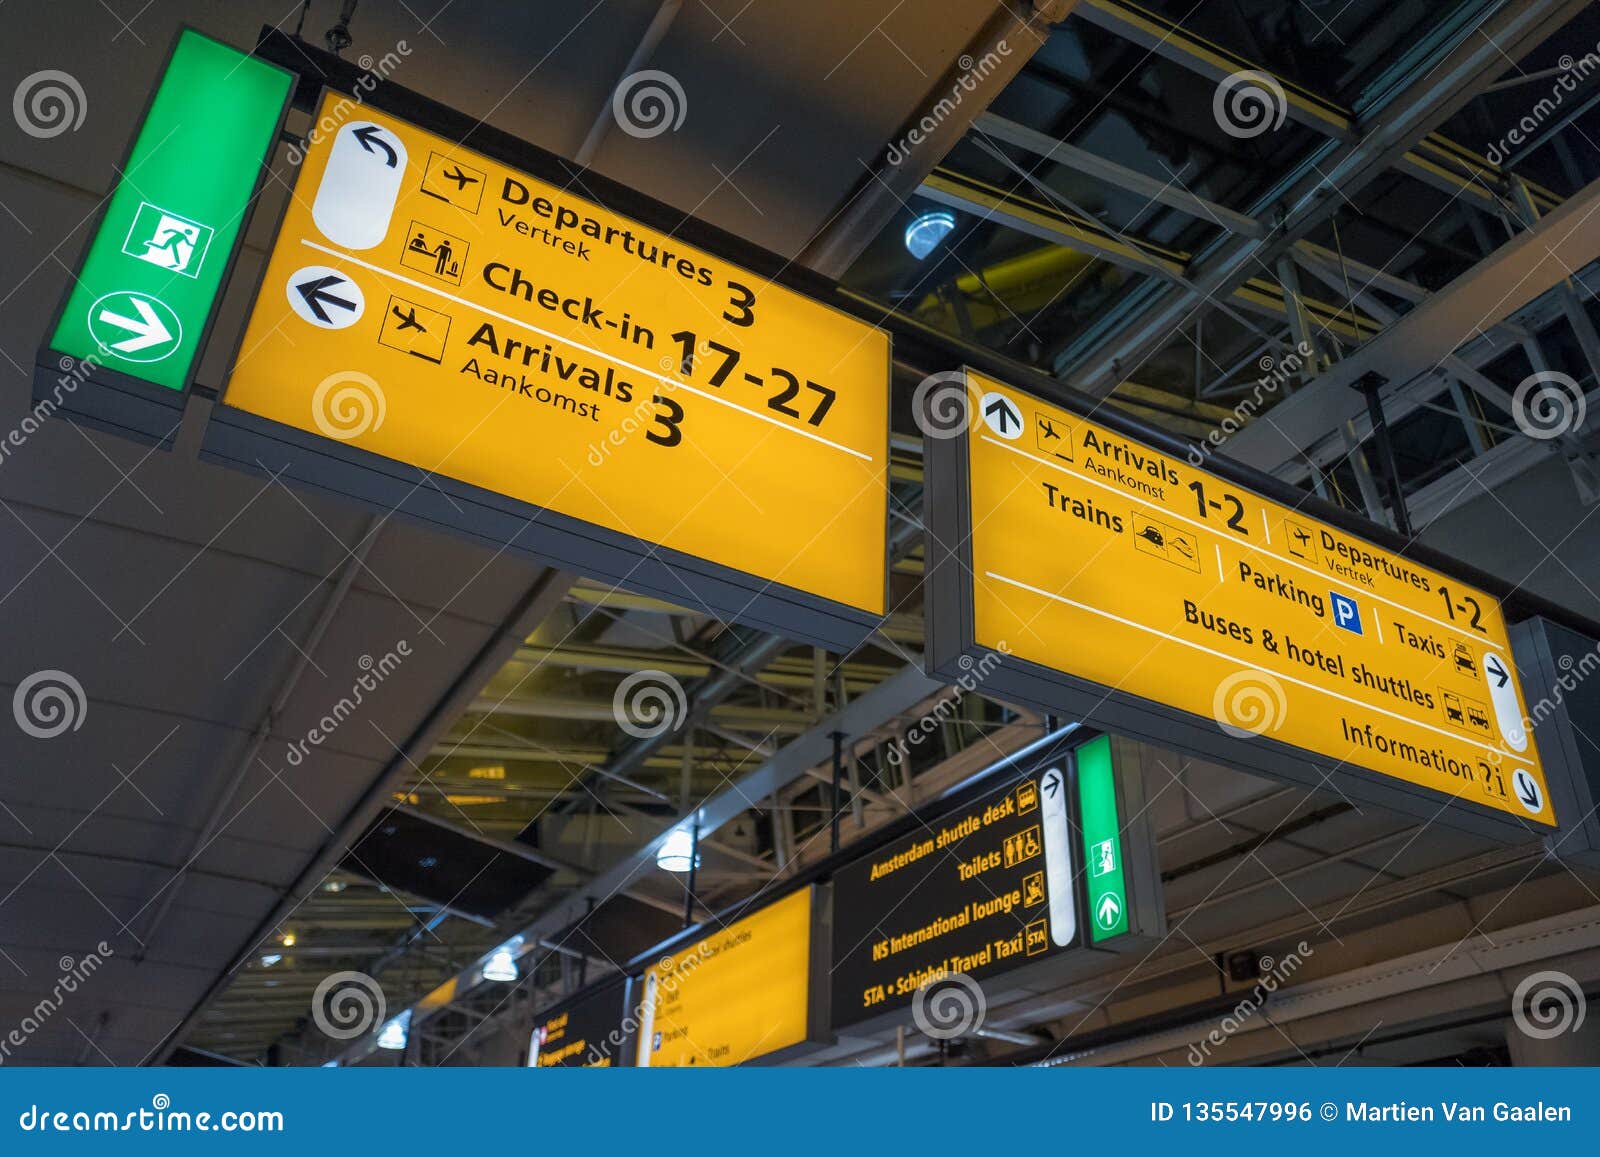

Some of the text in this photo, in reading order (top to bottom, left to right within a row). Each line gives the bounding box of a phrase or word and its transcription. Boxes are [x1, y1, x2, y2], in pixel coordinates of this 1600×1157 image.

[497, 208, 591, 262] Vertrek
[501, 177, 756, 328] Departures 3
[483, 262, 836, 427] Check-in 17-27
[460, 357, 601, 422] Aankomst
[467, 322, 684, 447] Arrivals 3
[1085, 457, 1165, 501] Aankomst
[1083, 430, 1487, 633] Arrivals 1-2 Departures 1-2
[1042, 482, 1123, 533] Trains
[1239, 561, 1325, 617] Parking
[1393, 621, 1446, 659] Taxis
[1326, 556, 1375, 588] Vertrek
[1184, 599, 1434, 709] Buses & hotel shuttles
[1341, 718, 1473, 781] Information
[869, 796, 1014, 881] Amsterdam shuttle desk
[957, 851, 1001, 881] Toilets
[872, 890, 1021, 961] NS International lounge
[1028, 932, 1046, 947] STA
[863, 985, 886, 1007] STA
[896, 958, 949, 995] Schiphol
[950, 949, 992, 977] Travel
[993, 931, 1023, 960] Taxi
